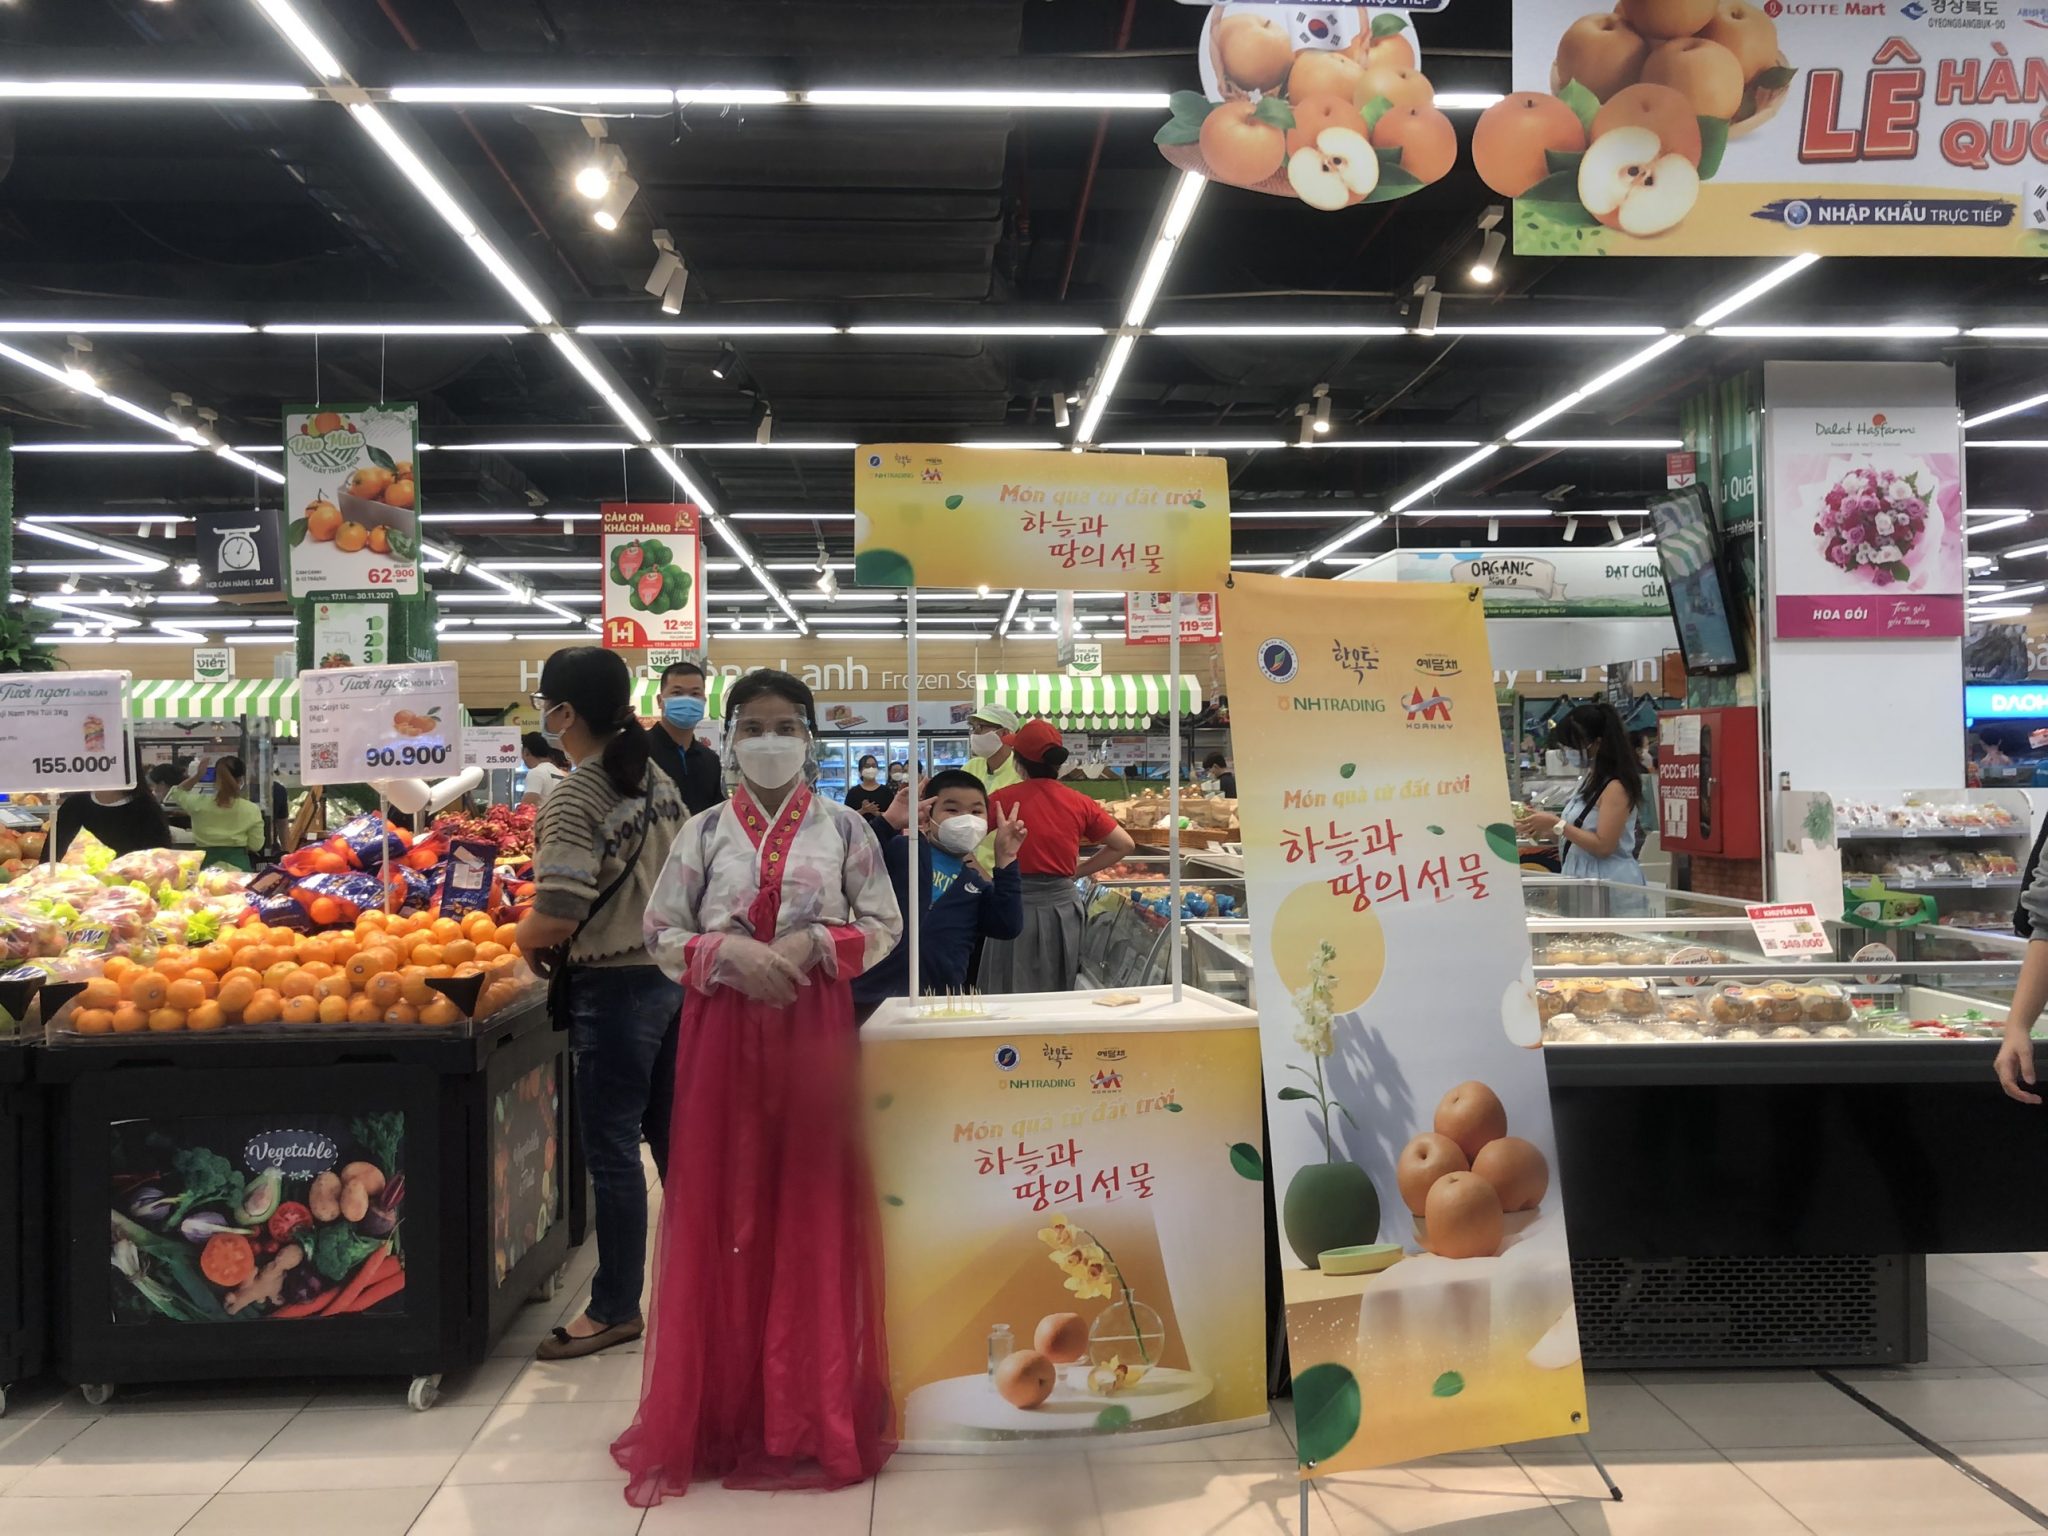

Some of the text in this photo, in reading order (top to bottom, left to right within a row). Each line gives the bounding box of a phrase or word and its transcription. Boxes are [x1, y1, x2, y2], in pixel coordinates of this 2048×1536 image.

[1787, 2, 1886, 16] LOTTE Mart
[1799, 36, 1925, 164] LÊ
[1818, 201, 2003, 225] NHẬP KHẨU TRỰC TIẾP
[1815, 420, 1852, 436] Dalat
[604, 522, 671, 533] KHÁCH HÀNG
[1020, 510, 1108, 539] 하늘과
[1049, 539, 1164, 574] 땅의 선물
[1605, 562, 1662, 580] ĐẠT CHỨN
[255, 577, 274, 586] SCALE
[356, 591, 394, 600] 30.11.2021
[1813, 606, 1868, 620] HOA GÓI
[366, 617, 373, 631] 1
[364, 634, 374, 647] 2
[363, 650, 374, 664] 3
[1416, 657, 1458, 672] 예담채
[34, 688, 71, 705] ngon
[1660, 763, 1700, 779] PCCC 114
[1283, 788, 1326, 810] Món
[1332, 784, 1368, 808] quà
[1400, 777, 1431, 800] đất
[1437, 774, 1471, 797] trời
[1280, 818, 1403, 867] 하늘과
[1327, 853, 1490, 913] 땅의 선물
[953, 1120, 1004, 1143] Món
[247, 1141, 333, 1165] Vegetable
[974, 1138, 1084, 1176] 하늘과
[1012, 1162, 1155, 1212] 땅의 선물
